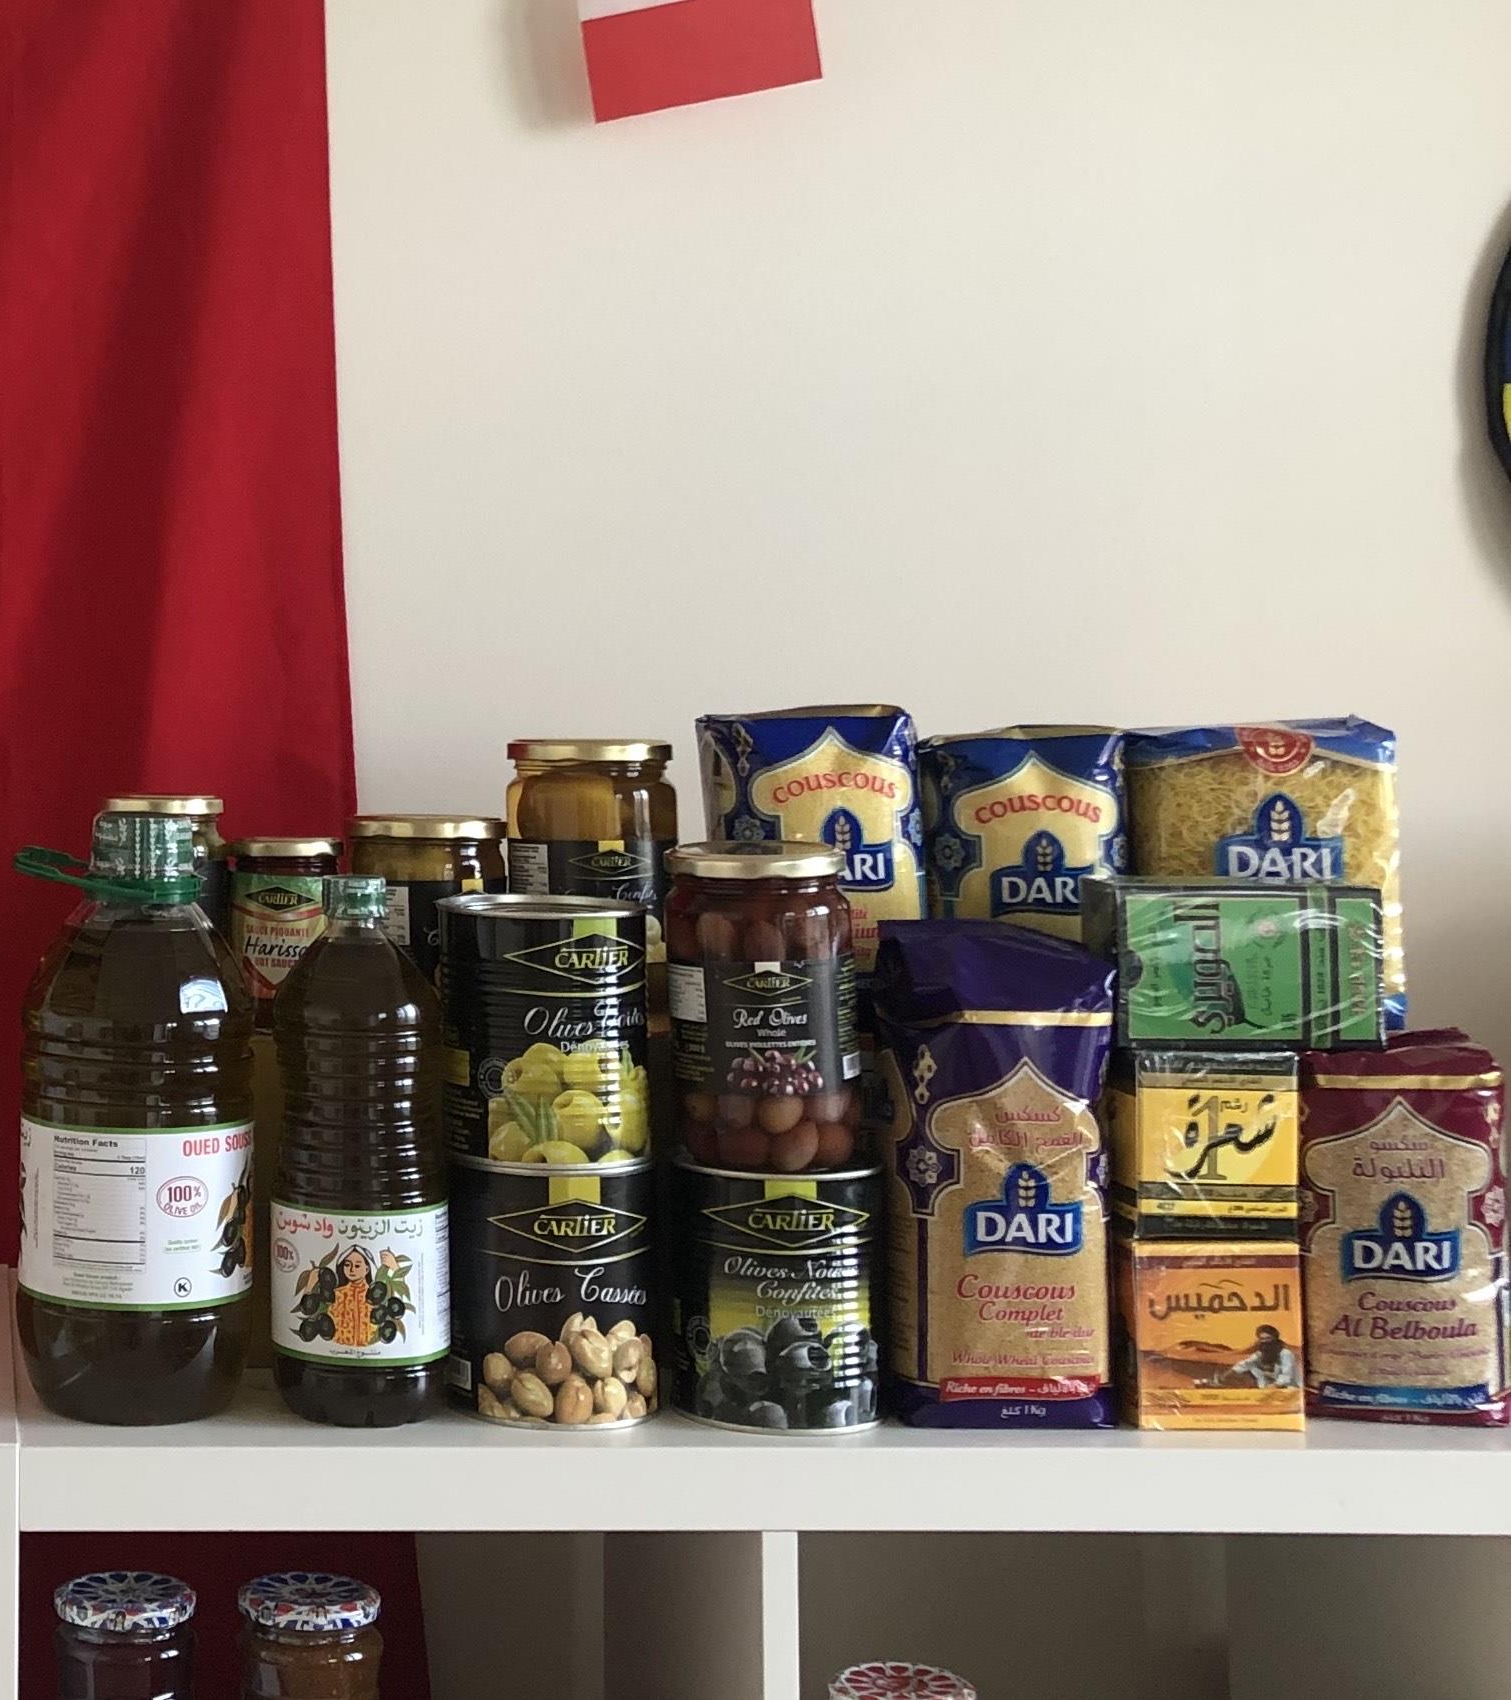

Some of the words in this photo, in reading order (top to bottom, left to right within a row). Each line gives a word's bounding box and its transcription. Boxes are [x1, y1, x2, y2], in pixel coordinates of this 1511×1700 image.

[1227, 844, 1335, 884] DARI
[1000, 875, 1081, 905] DAR
[523, 1006, 594, 1039] Olives
[732, 1007, 765, 1029] Red
[768, 1007, 808, 1026] Olives
[756, 1027, 787, 1038] Whole
[1220, 1098, 1249, 1113] رقم
[54, 1135, 90, 1147] Nutrition
[91, 1139, 119, 1148] Facts
[182, 1138, 220, 1158] OUED
[129, 1166, 146, 1175] 120
[167, 1185, 202, 1204] 100%
[313, 1219, 335, 1239] واد
[337, 1218, 391, 1241] الزيتون
[394, 1218, 425, 1240] زيت
[975, 1210, 1074, 1246] DARI
[1352, 1239, 1452, 1271] DARI
[724, 1255, 789, 1279] Olives
[493, 1269, 565, 1313] Olives
[956, 1272, 1077, 1302] Couscous
[1357, 1290, 1457, 1313] Couscous
[977, 1300, 1066, 1327] Complet
[1368, 1315, 1479, 1341] Belboula
